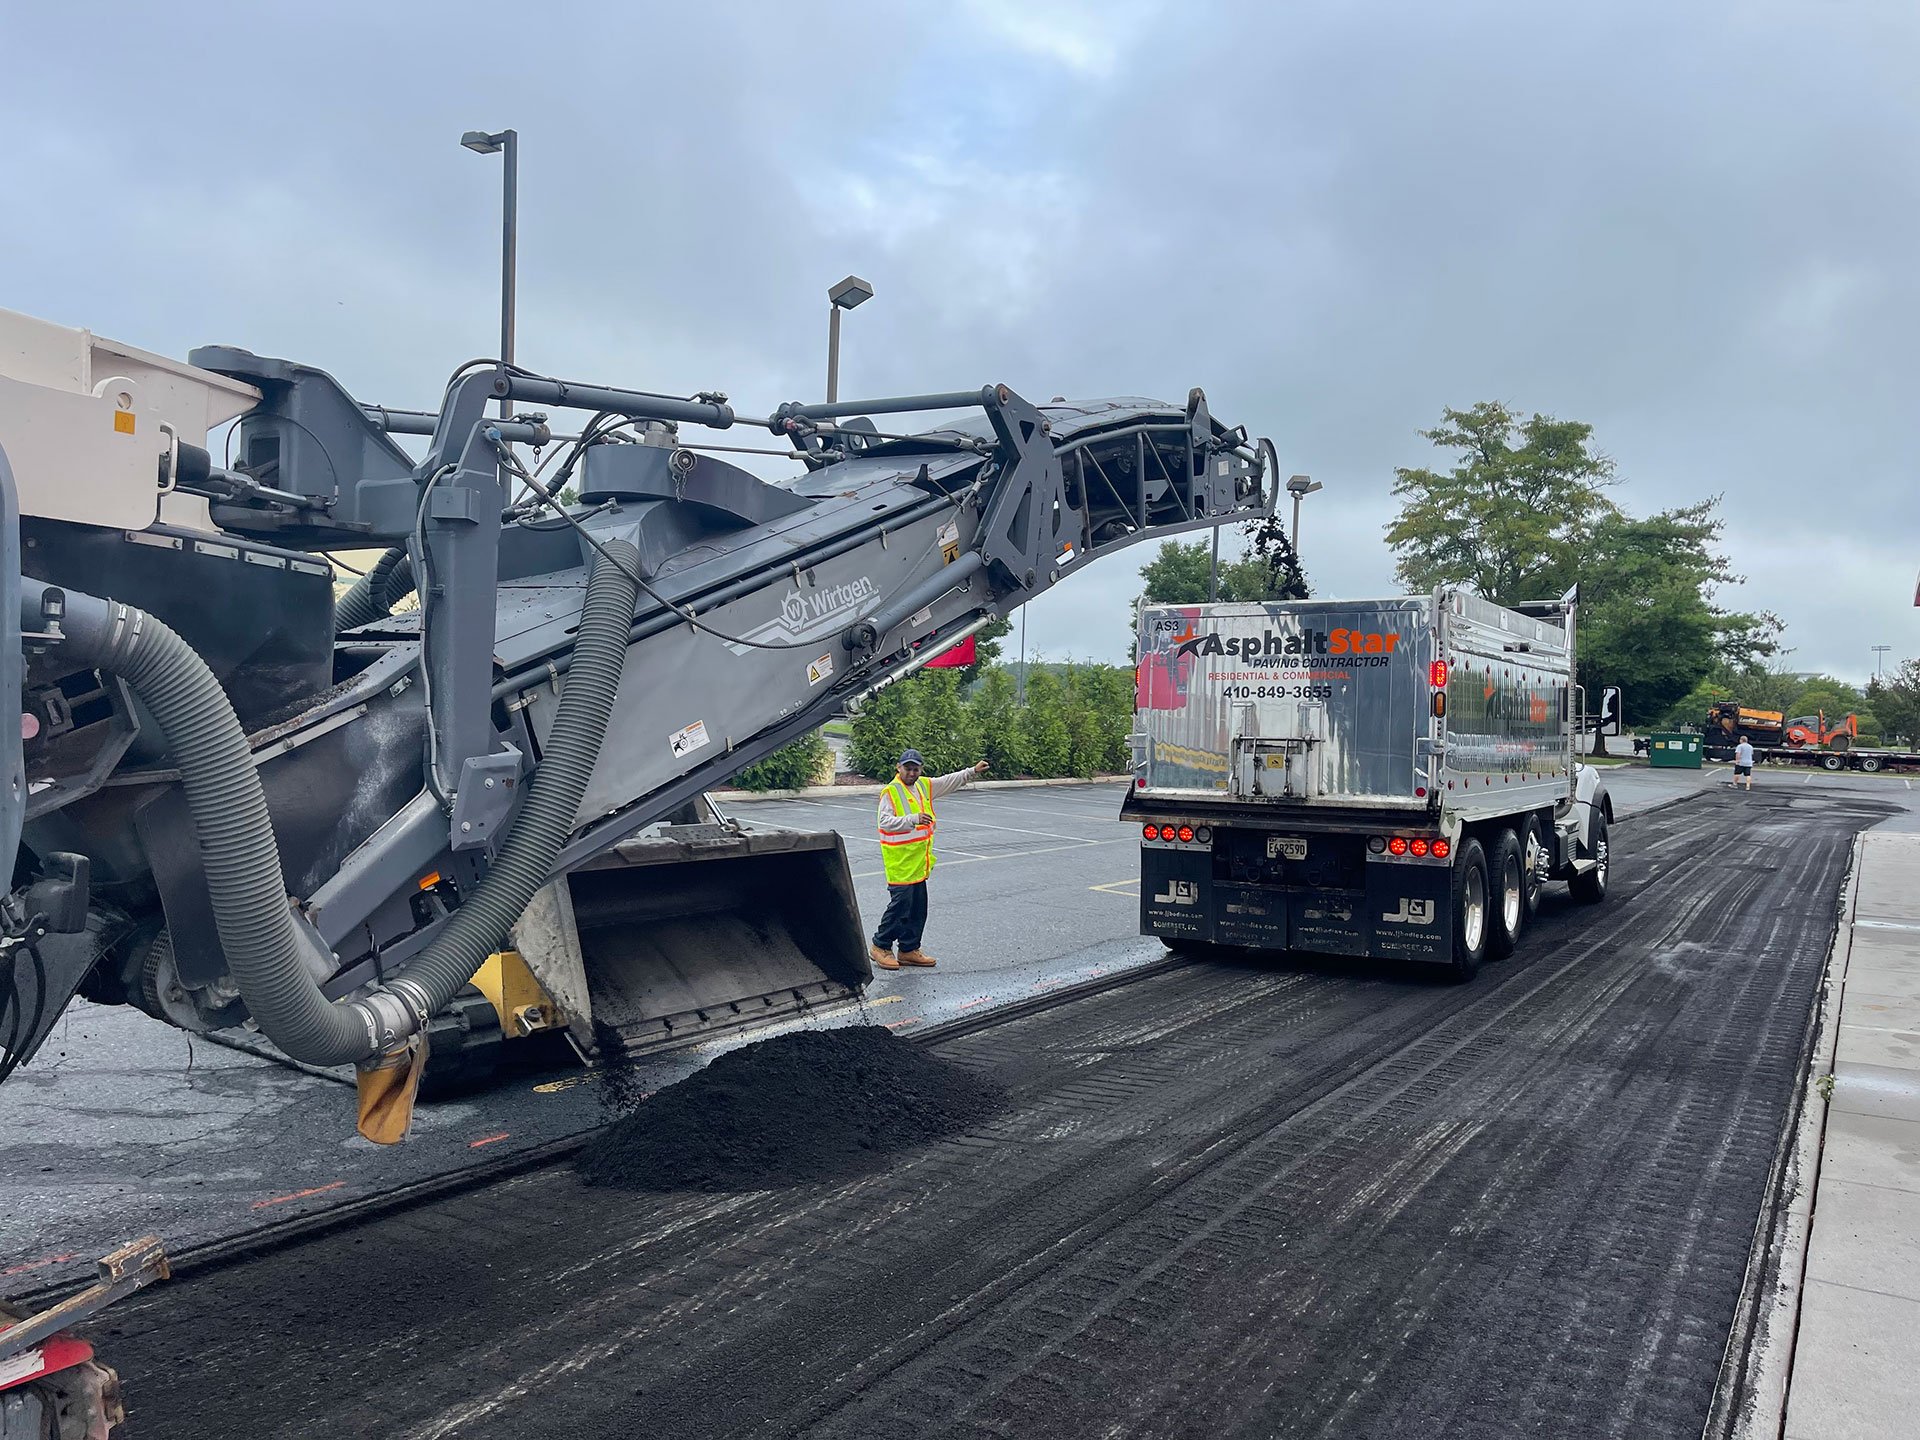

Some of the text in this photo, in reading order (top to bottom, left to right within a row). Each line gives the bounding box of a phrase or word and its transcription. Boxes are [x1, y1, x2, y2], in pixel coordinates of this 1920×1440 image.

[808, 576, 873, 616] Wirtgen
[1155, 621, 1180, 632] AS3
[1252, 657, 1390, 669] PAVING CONTRACTOR
[1208, 671, 1352, 681] RESIDENTIAL & COMMERCIAL
[1223, 686, 1333, 699] 410-849-3655
